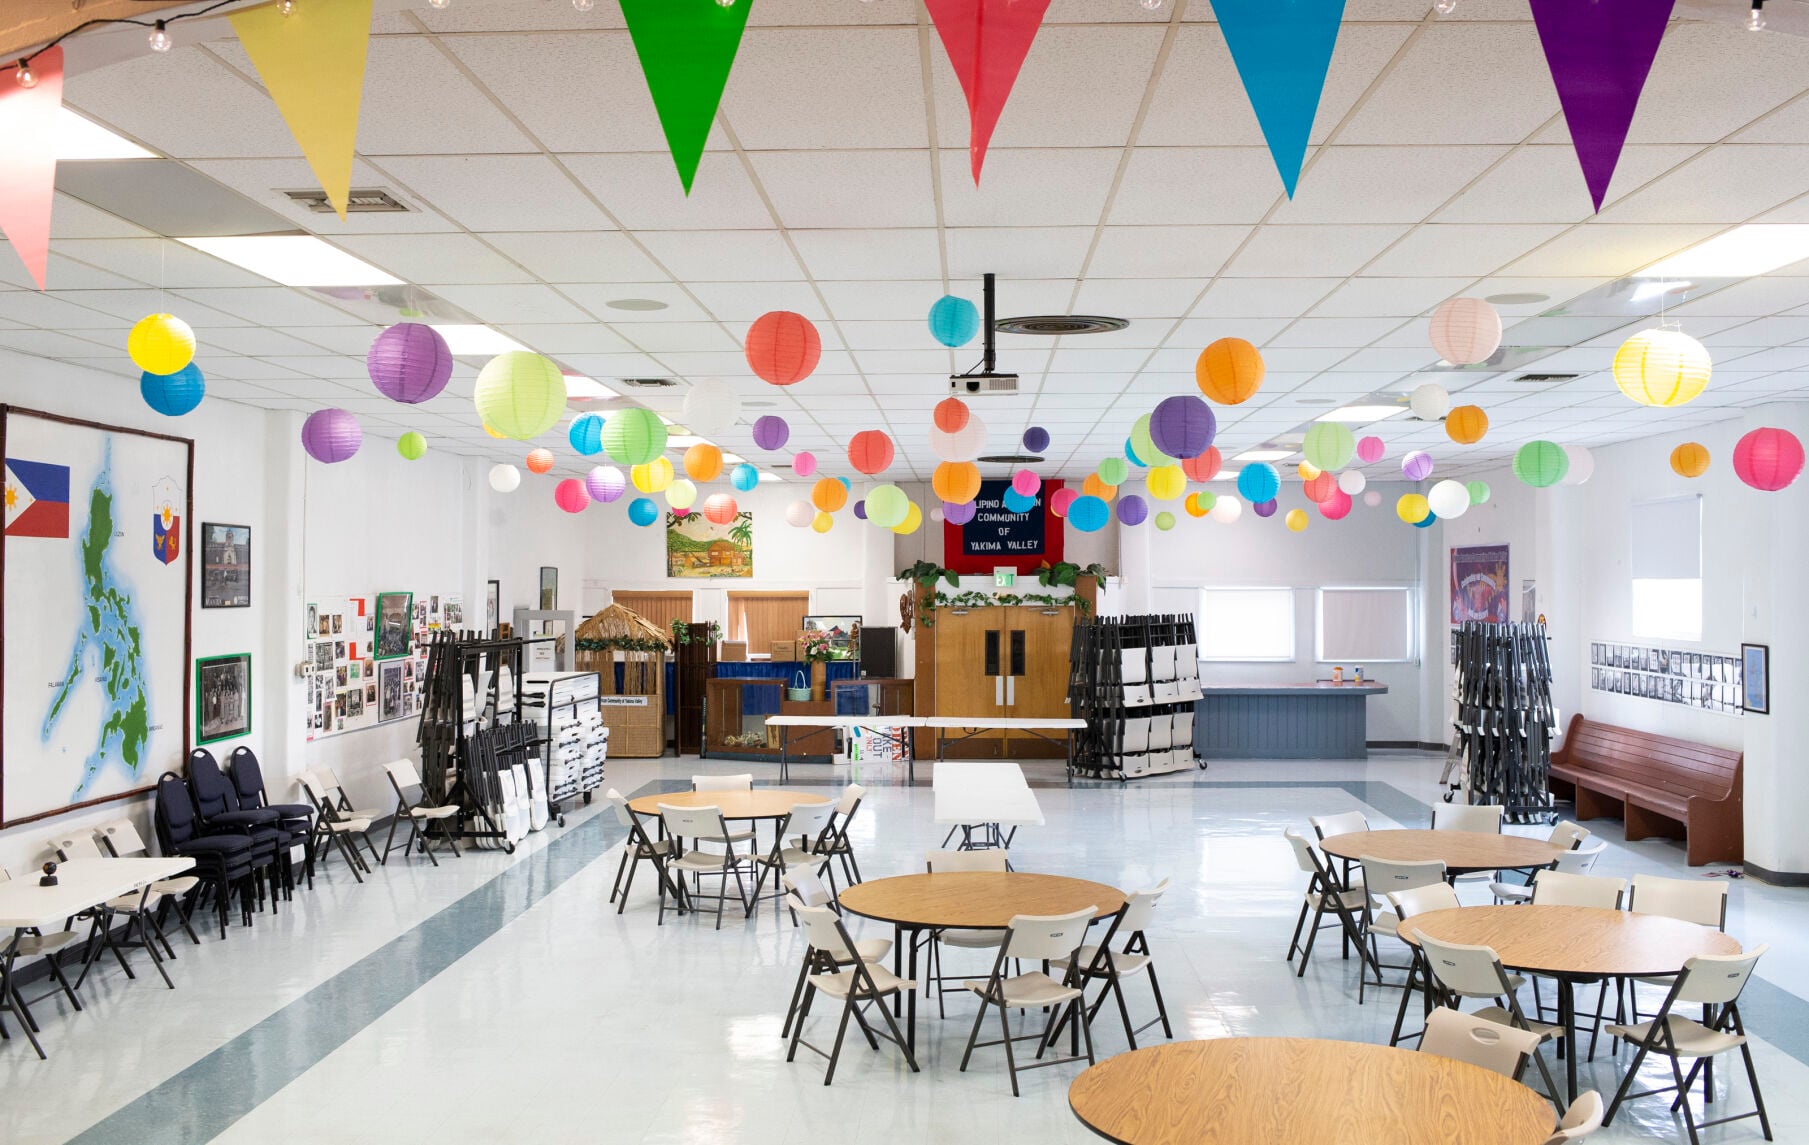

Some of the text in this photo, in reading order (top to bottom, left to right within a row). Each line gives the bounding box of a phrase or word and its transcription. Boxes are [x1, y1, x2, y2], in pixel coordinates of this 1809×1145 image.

[977, 512, 1030, 522] COMMUNITY
[998, 527, 1011, 536] OF
[970, 540, 1039, 551] YAKIMA VALLEY
[996, 574, 1015, 587] EXIT
[872, 737, 882, 758] OUT
